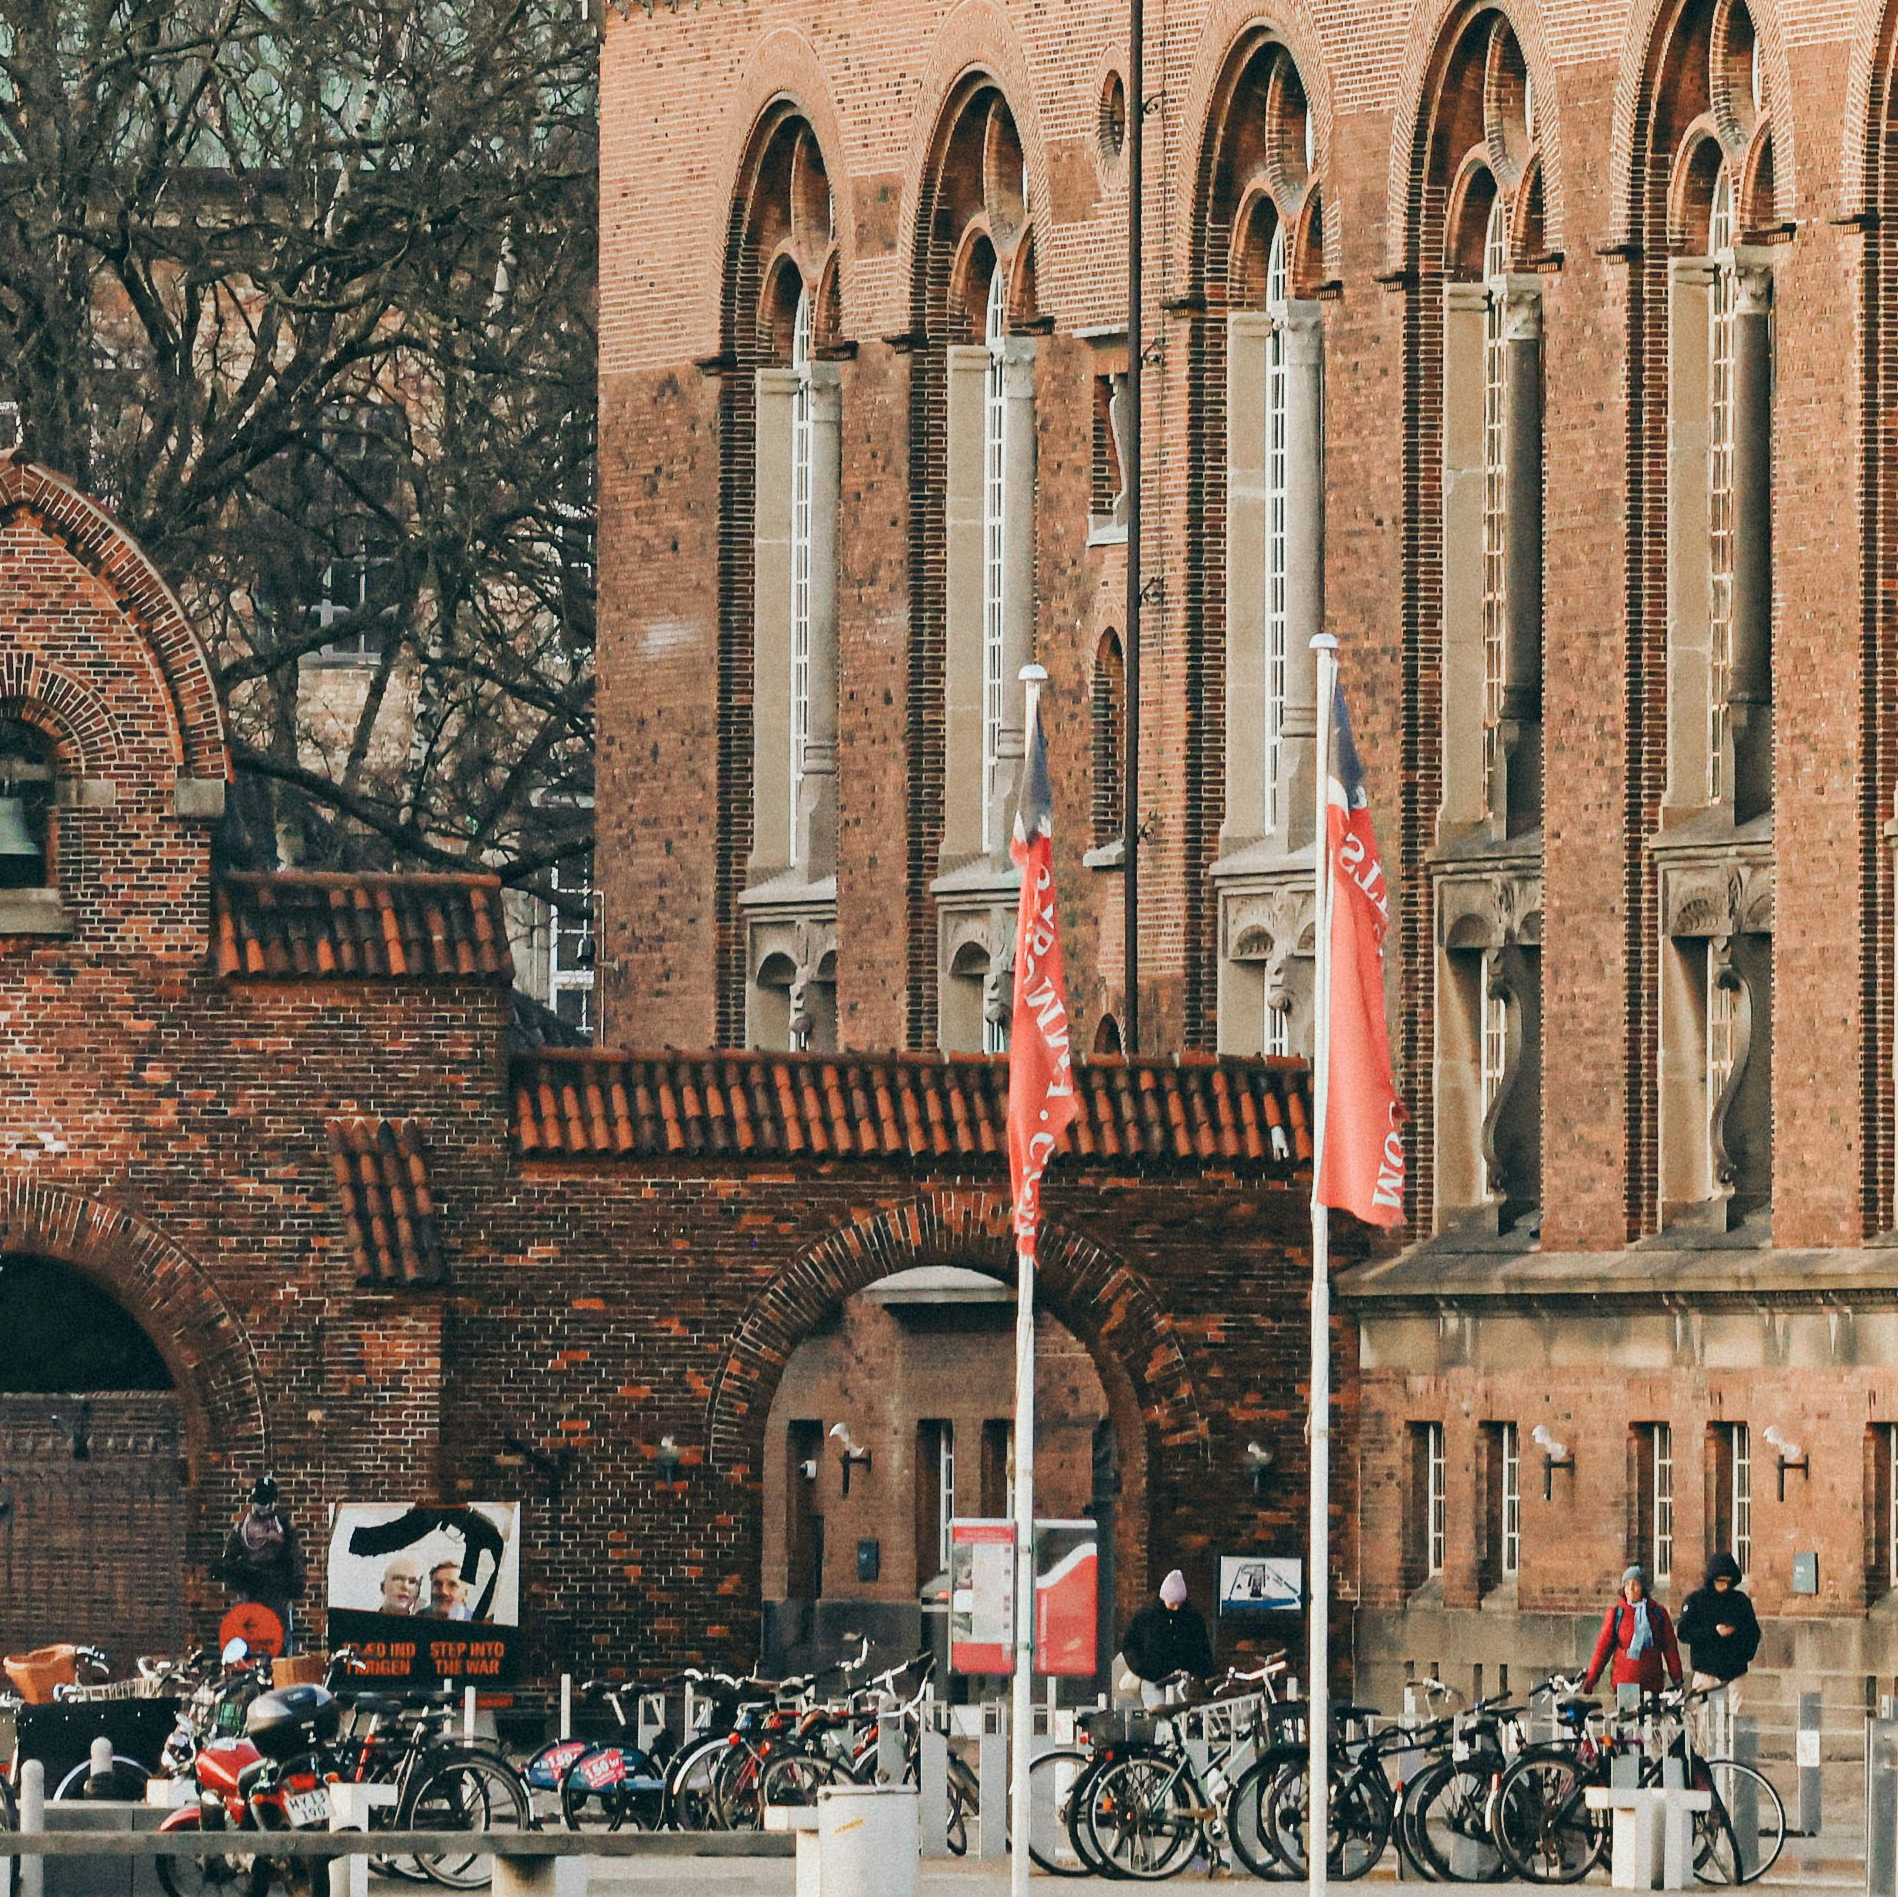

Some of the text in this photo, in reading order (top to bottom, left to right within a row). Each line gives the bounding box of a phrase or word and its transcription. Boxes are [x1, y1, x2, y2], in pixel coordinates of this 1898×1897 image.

[430, 1642, 504, 1658] STEP INTO
[435, 1660, 500, 1675] THE WAR
